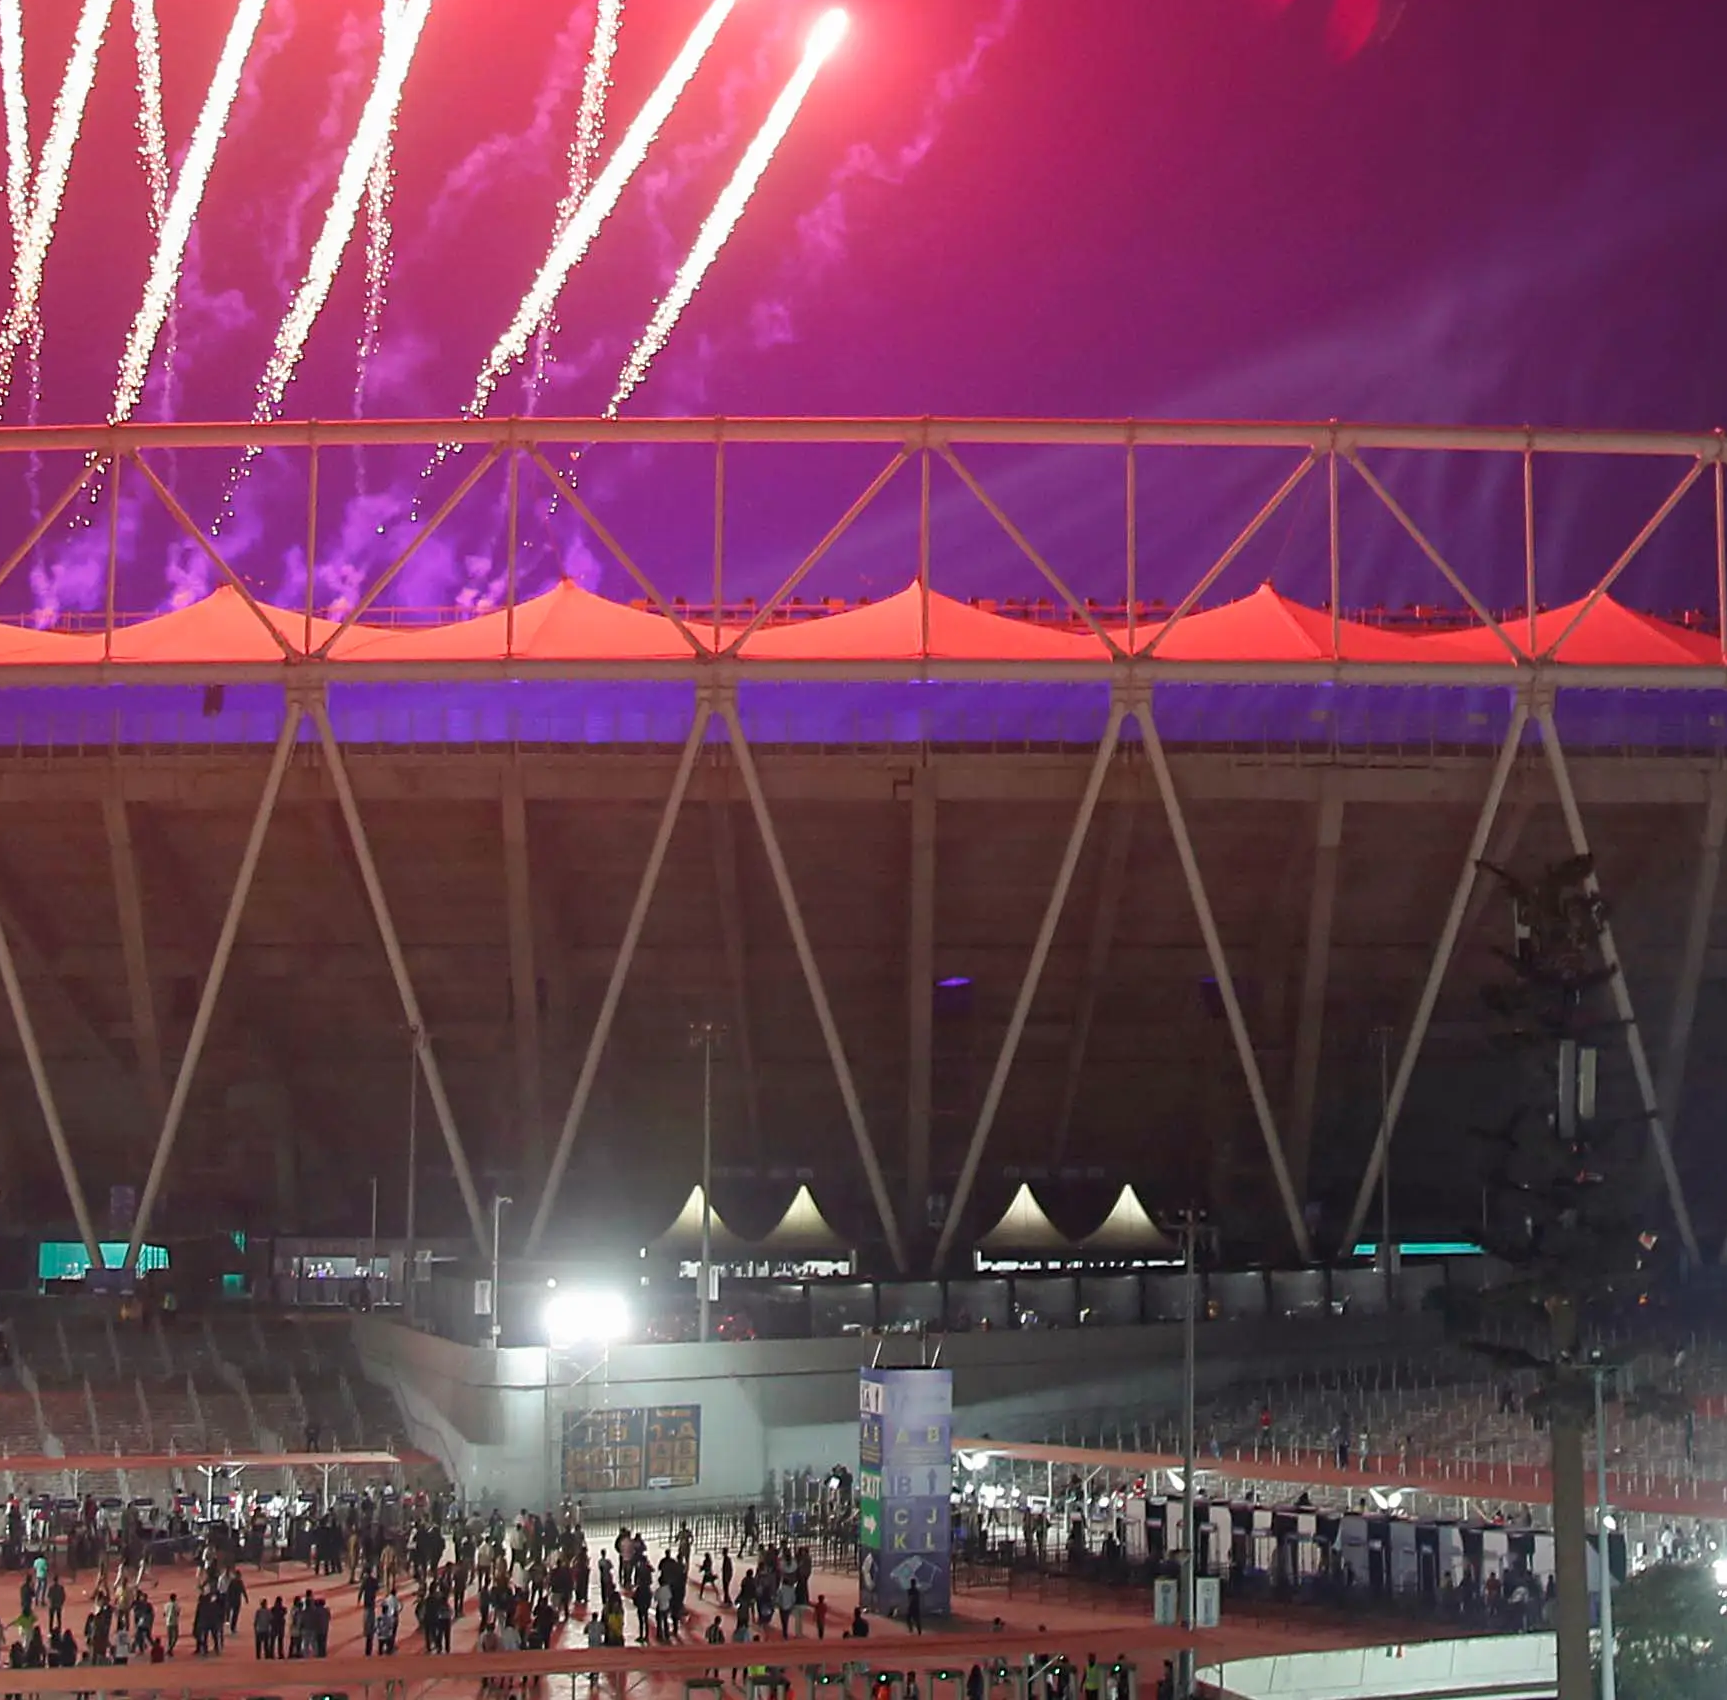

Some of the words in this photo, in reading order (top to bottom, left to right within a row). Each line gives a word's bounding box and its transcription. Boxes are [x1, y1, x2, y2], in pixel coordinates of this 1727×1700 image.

[861, 1471, 881, 1500] EXIT
[889, 1474, 912, 1496] 1B
[894, 1508, 909, 1525] C
[927, 1506, 937, 1525] J
[894, 1532, 907, 1549] K
[926, 1532, 936, 1549] L
